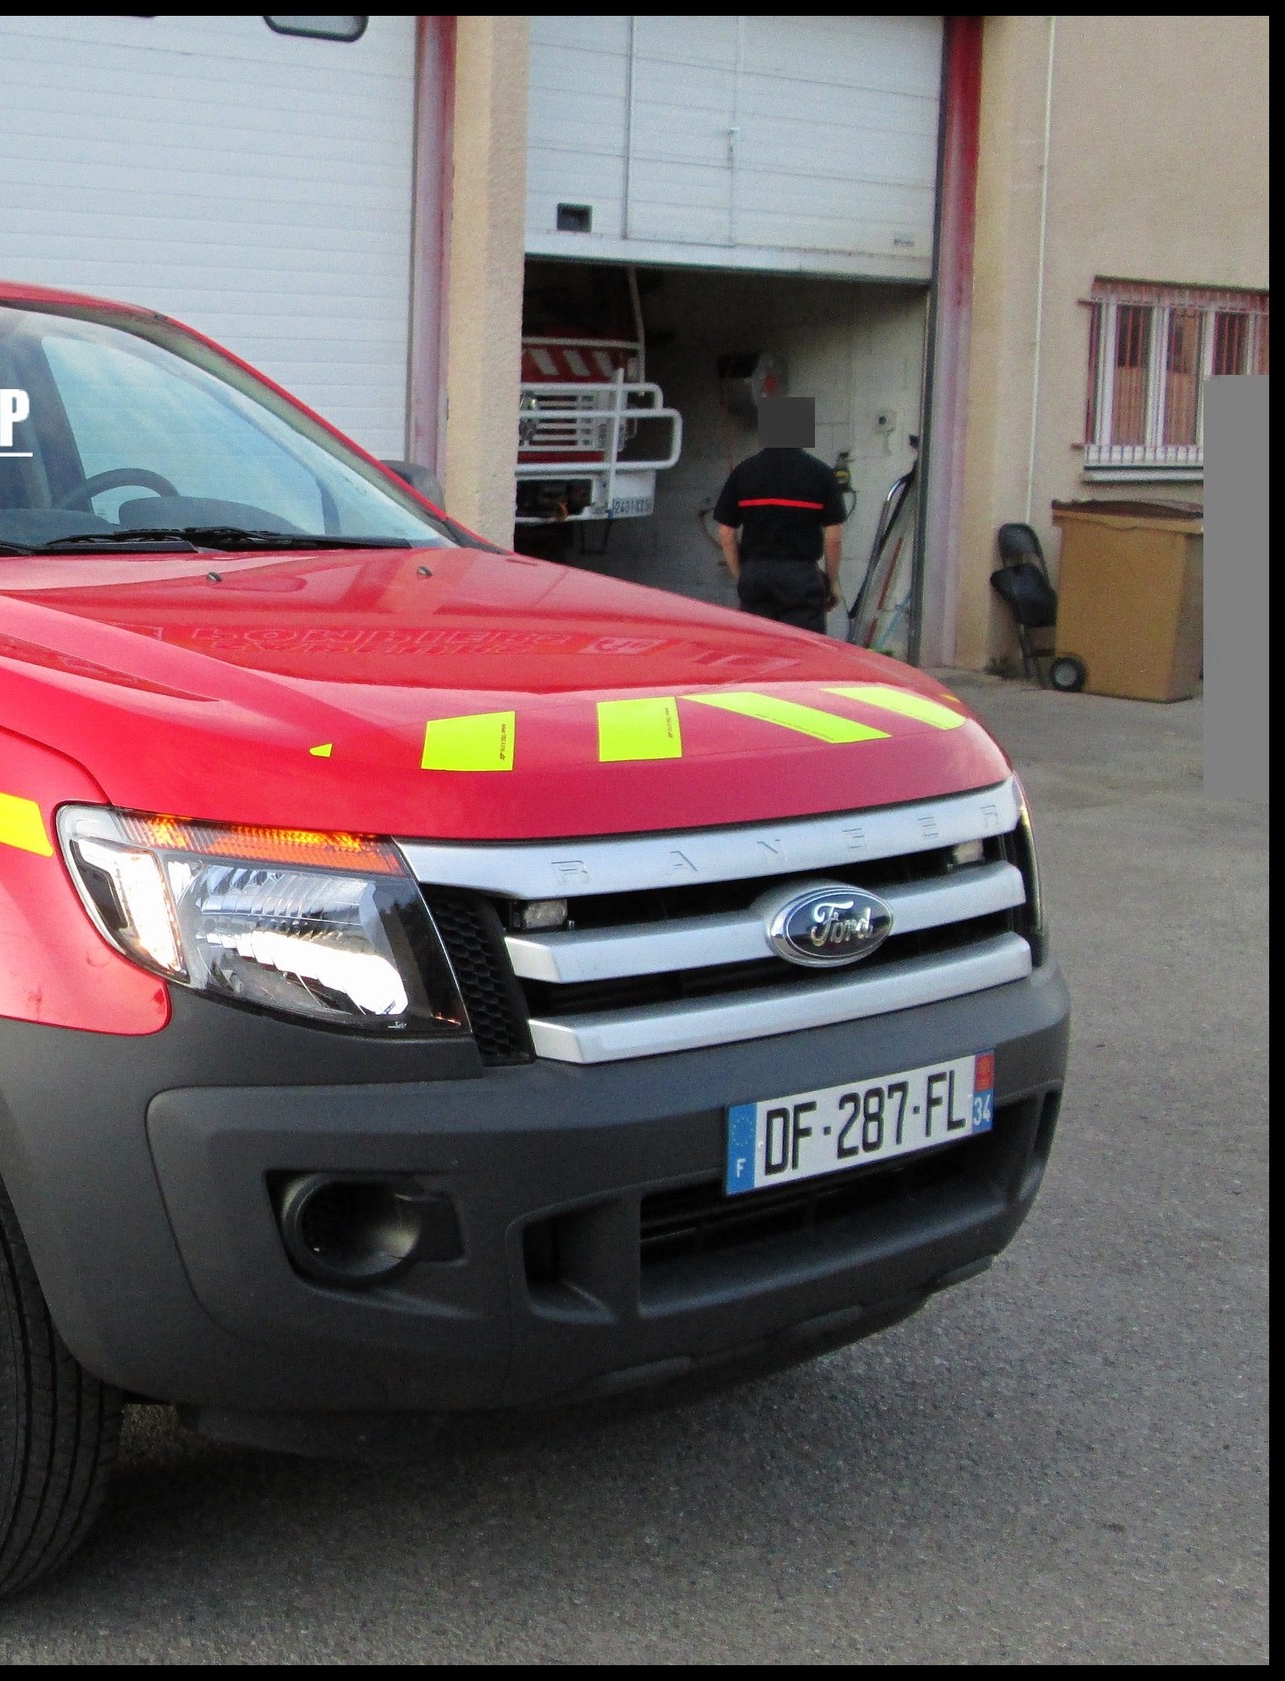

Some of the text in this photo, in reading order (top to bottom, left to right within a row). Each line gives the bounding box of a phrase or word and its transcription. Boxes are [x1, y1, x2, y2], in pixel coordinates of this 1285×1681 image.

[550, 803, 1000, 887] RANGER
[810, 900, 875, 947] Ford
[735, 1069, 992, 1179] F DF-287-FL 34
